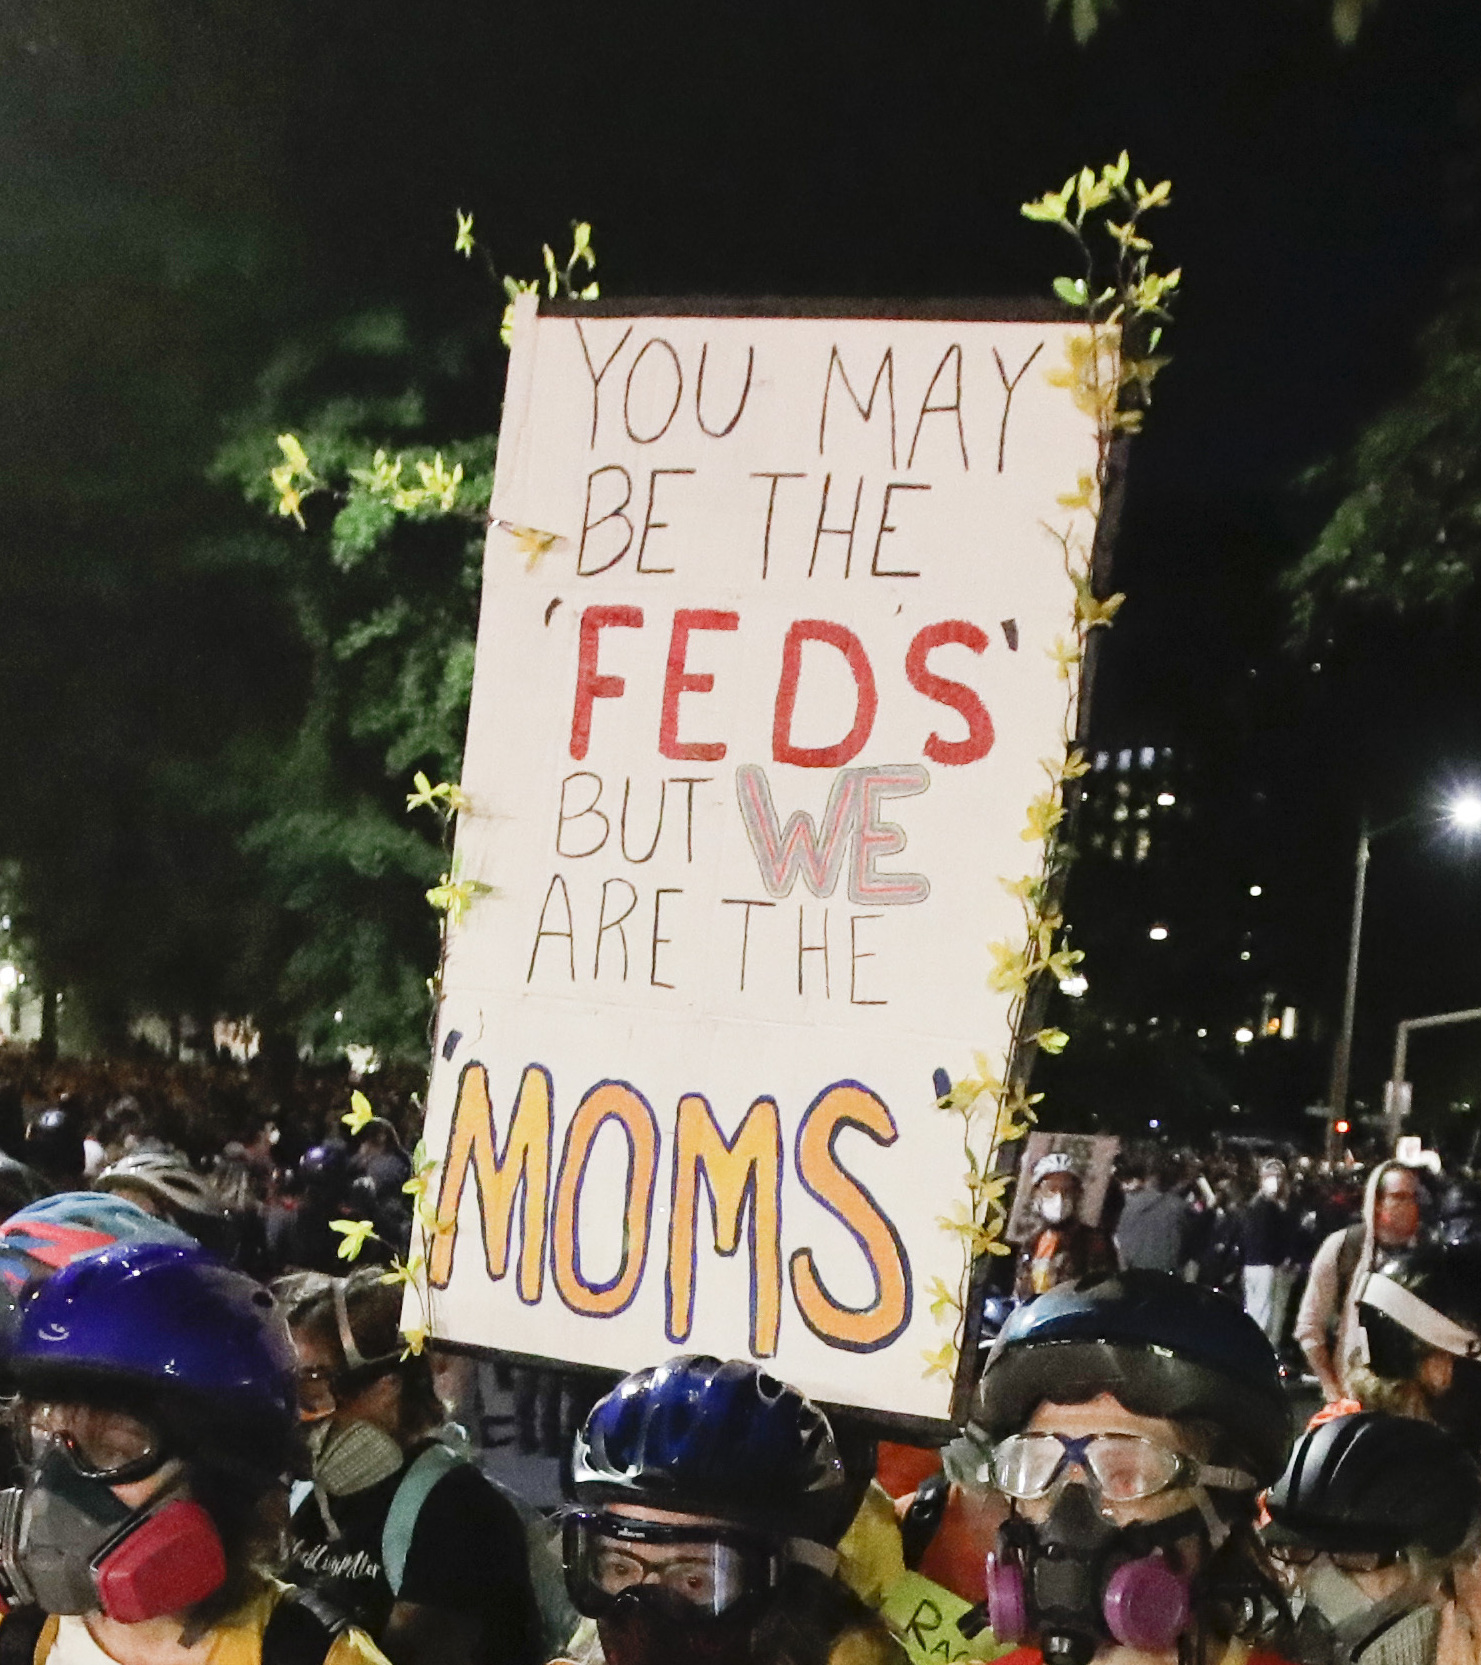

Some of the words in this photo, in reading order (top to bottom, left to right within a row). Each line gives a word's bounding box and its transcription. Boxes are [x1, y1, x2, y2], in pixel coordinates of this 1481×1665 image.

[576, 319, 753, 450] YOU
[820, 341, 1044, 473] MAY
[576, 464, 696, 577] BE
[750, 471, 932, 579] THE
[555, 771, 714, 864] BUT
[736, 763, 930, 905] WE
[526, 873, 684, 989] ARE
[720, 898, 889, 1005] THE
